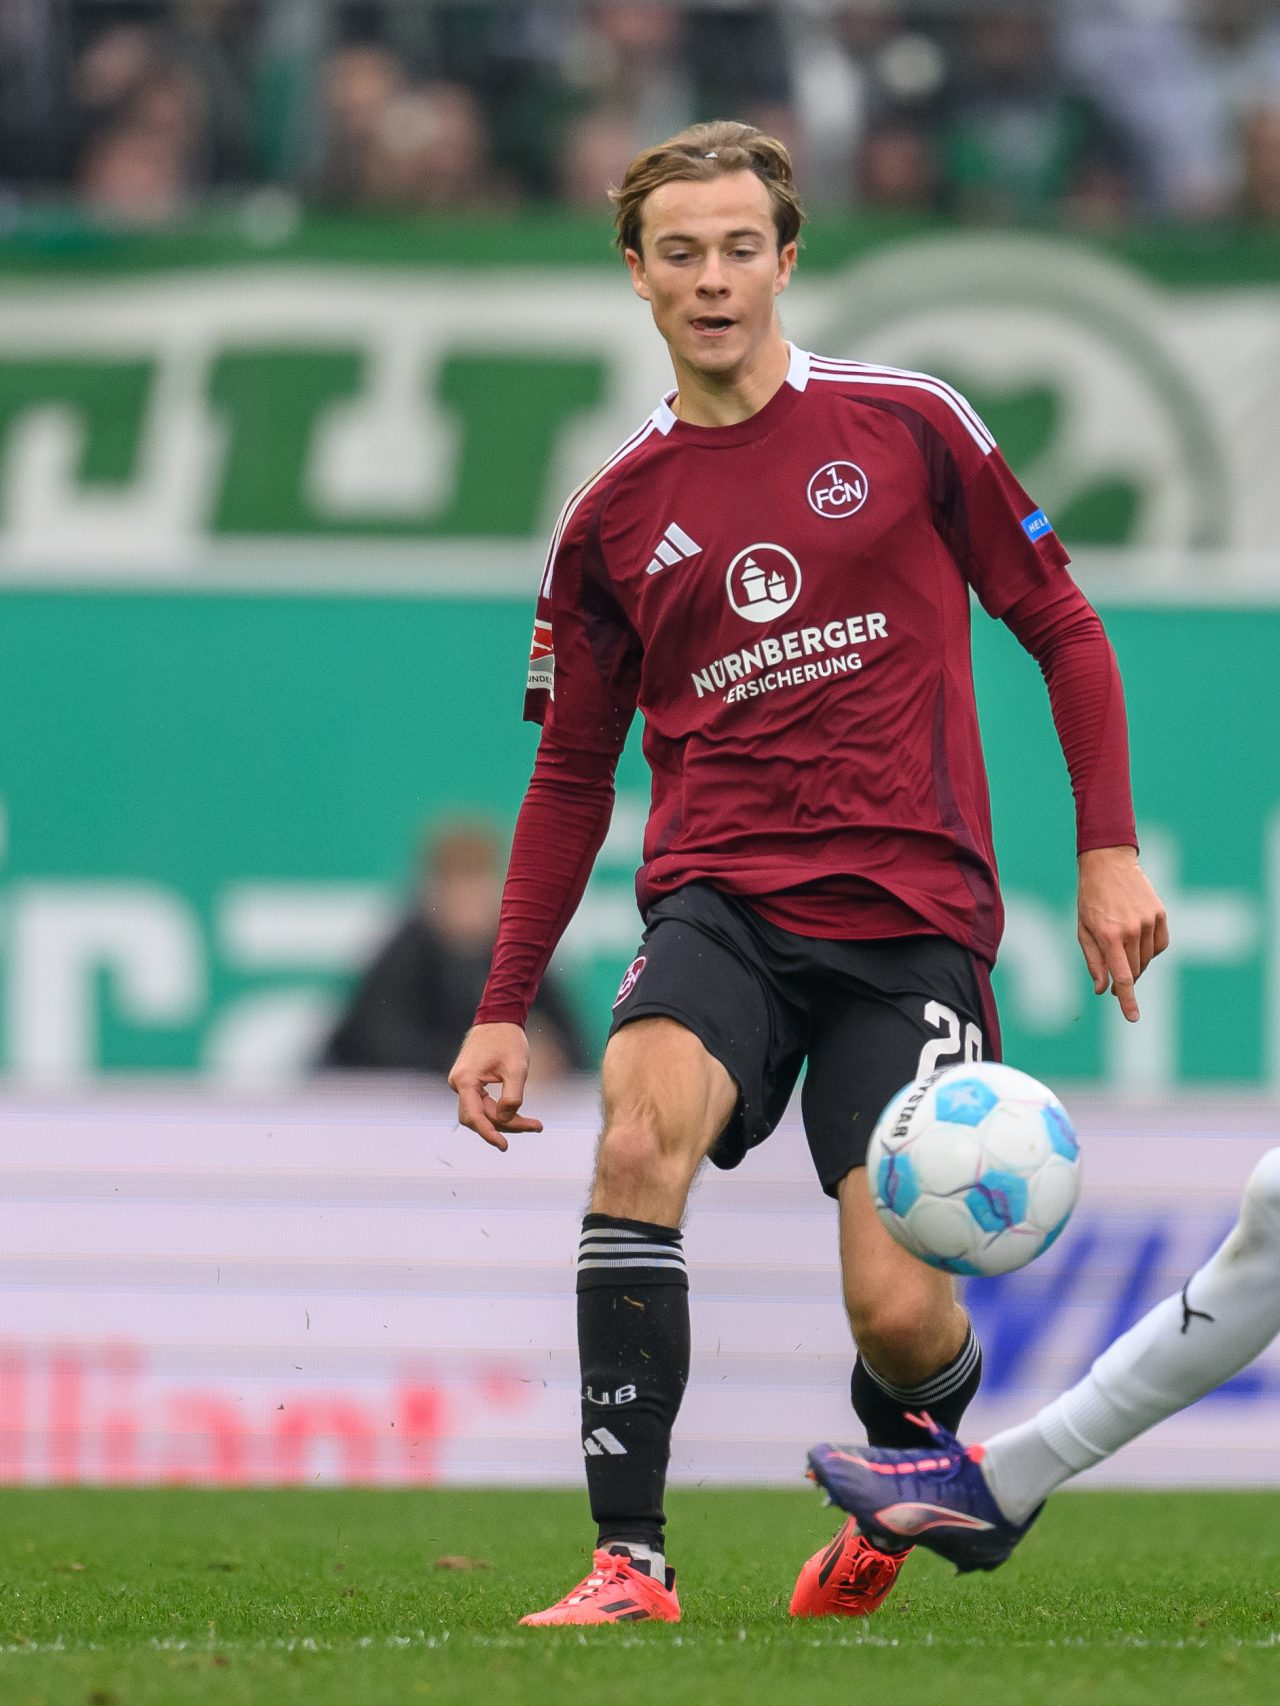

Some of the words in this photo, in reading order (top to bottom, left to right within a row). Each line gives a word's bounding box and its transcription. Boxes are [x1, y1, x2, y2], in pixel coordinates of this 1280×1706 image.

[815, 479, 863, 509] FCN
[691, 612, 888, 699] NÜRNBERGER
[722, 652, 863, 705] ERSICHERUNG
